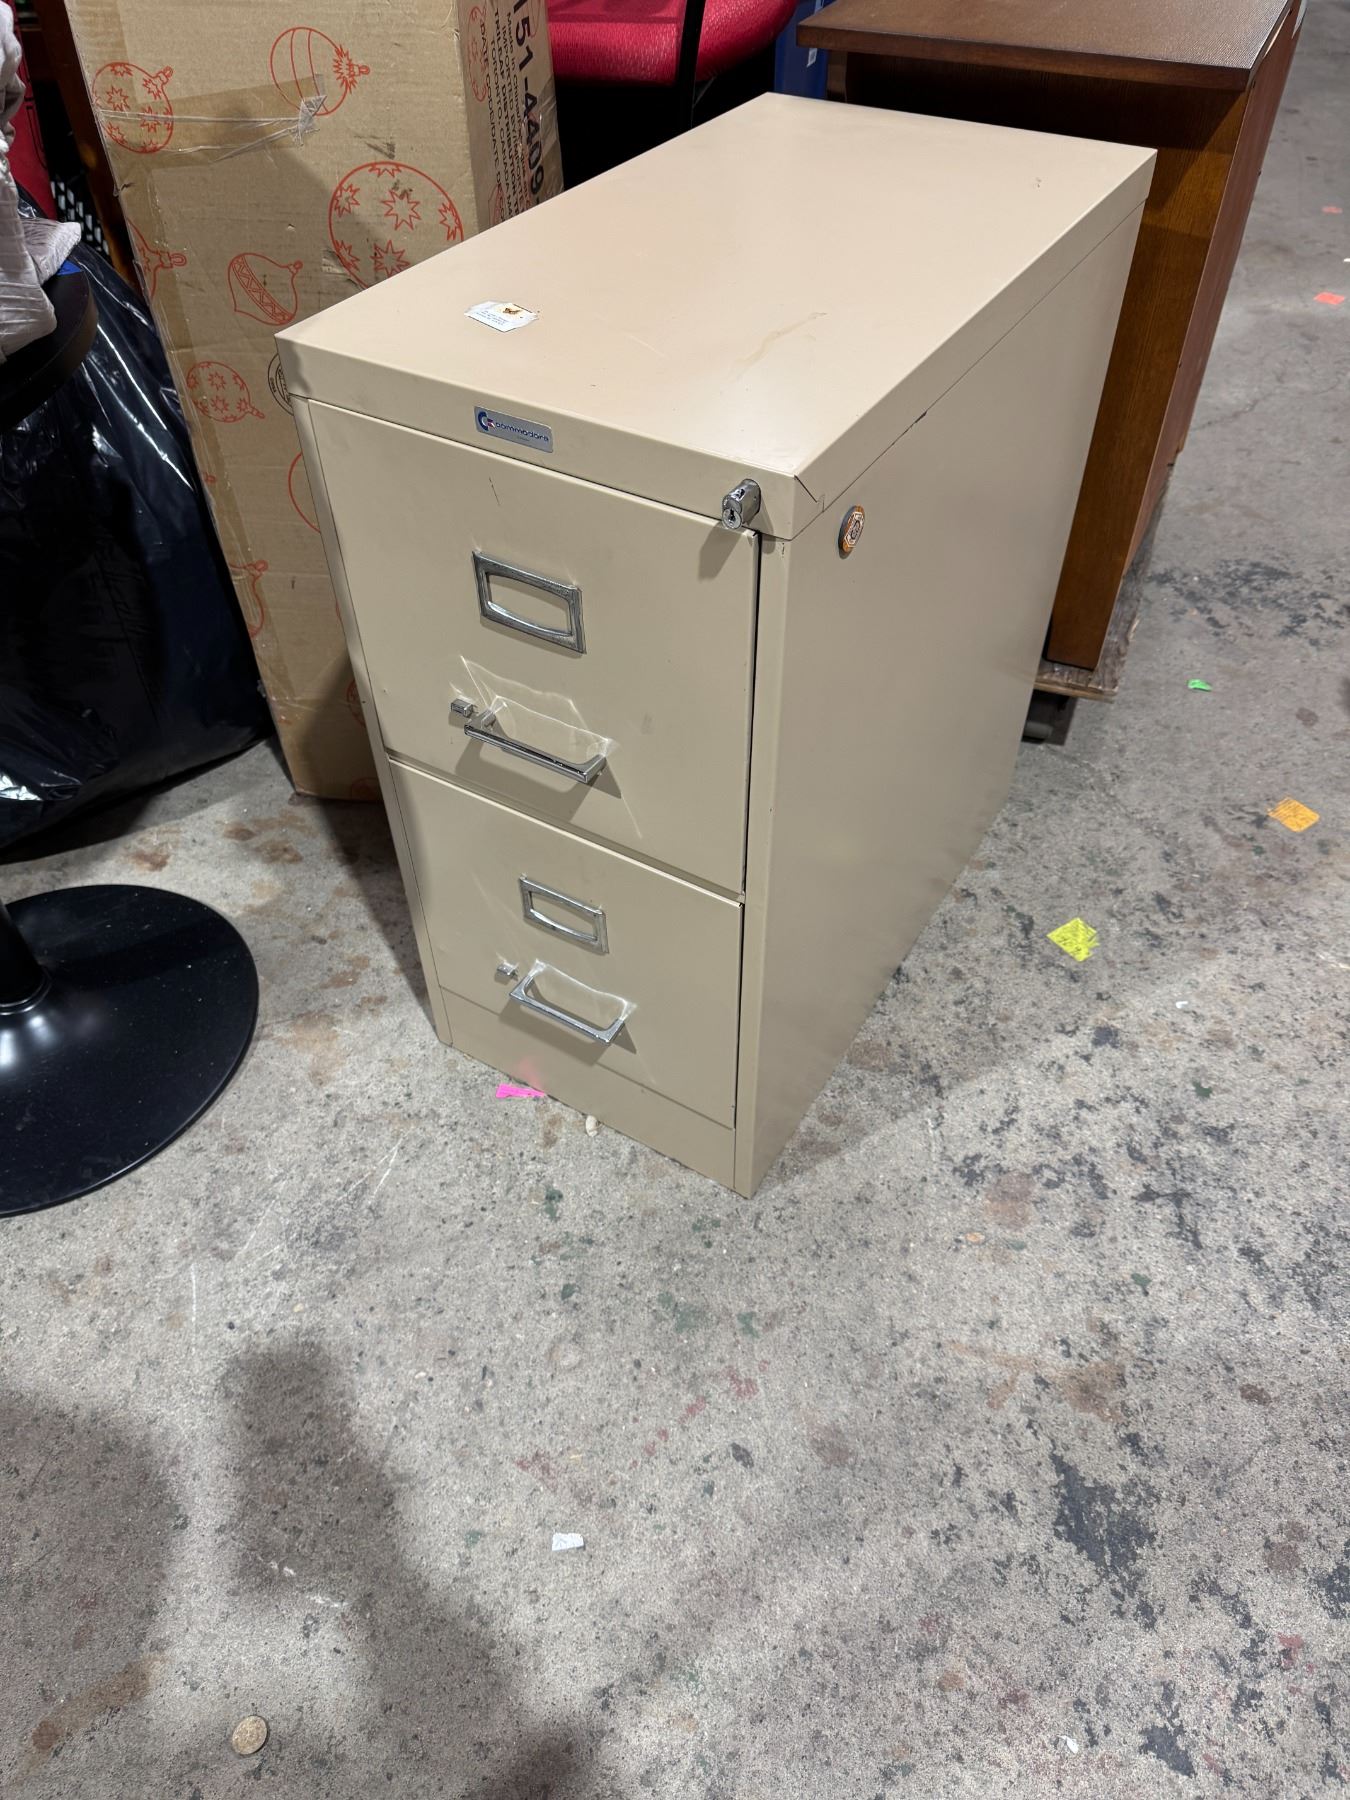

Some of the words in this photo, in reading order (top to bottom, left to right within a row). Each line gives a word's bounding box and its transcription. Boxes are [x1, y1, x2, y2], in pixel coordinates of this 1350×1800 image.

[481, 22, 489, 66] DATE
[486, 74, 500, 169] CODE/DATE
[495, 8, 504, 79] TRILEAF
[502, 85, 516, 196] DISTRIBUTION
[502, 26, 513, 112] IMPORTED
[500, 128, 510, 193] CANADA
[495, 422, 549, 442] commodore
